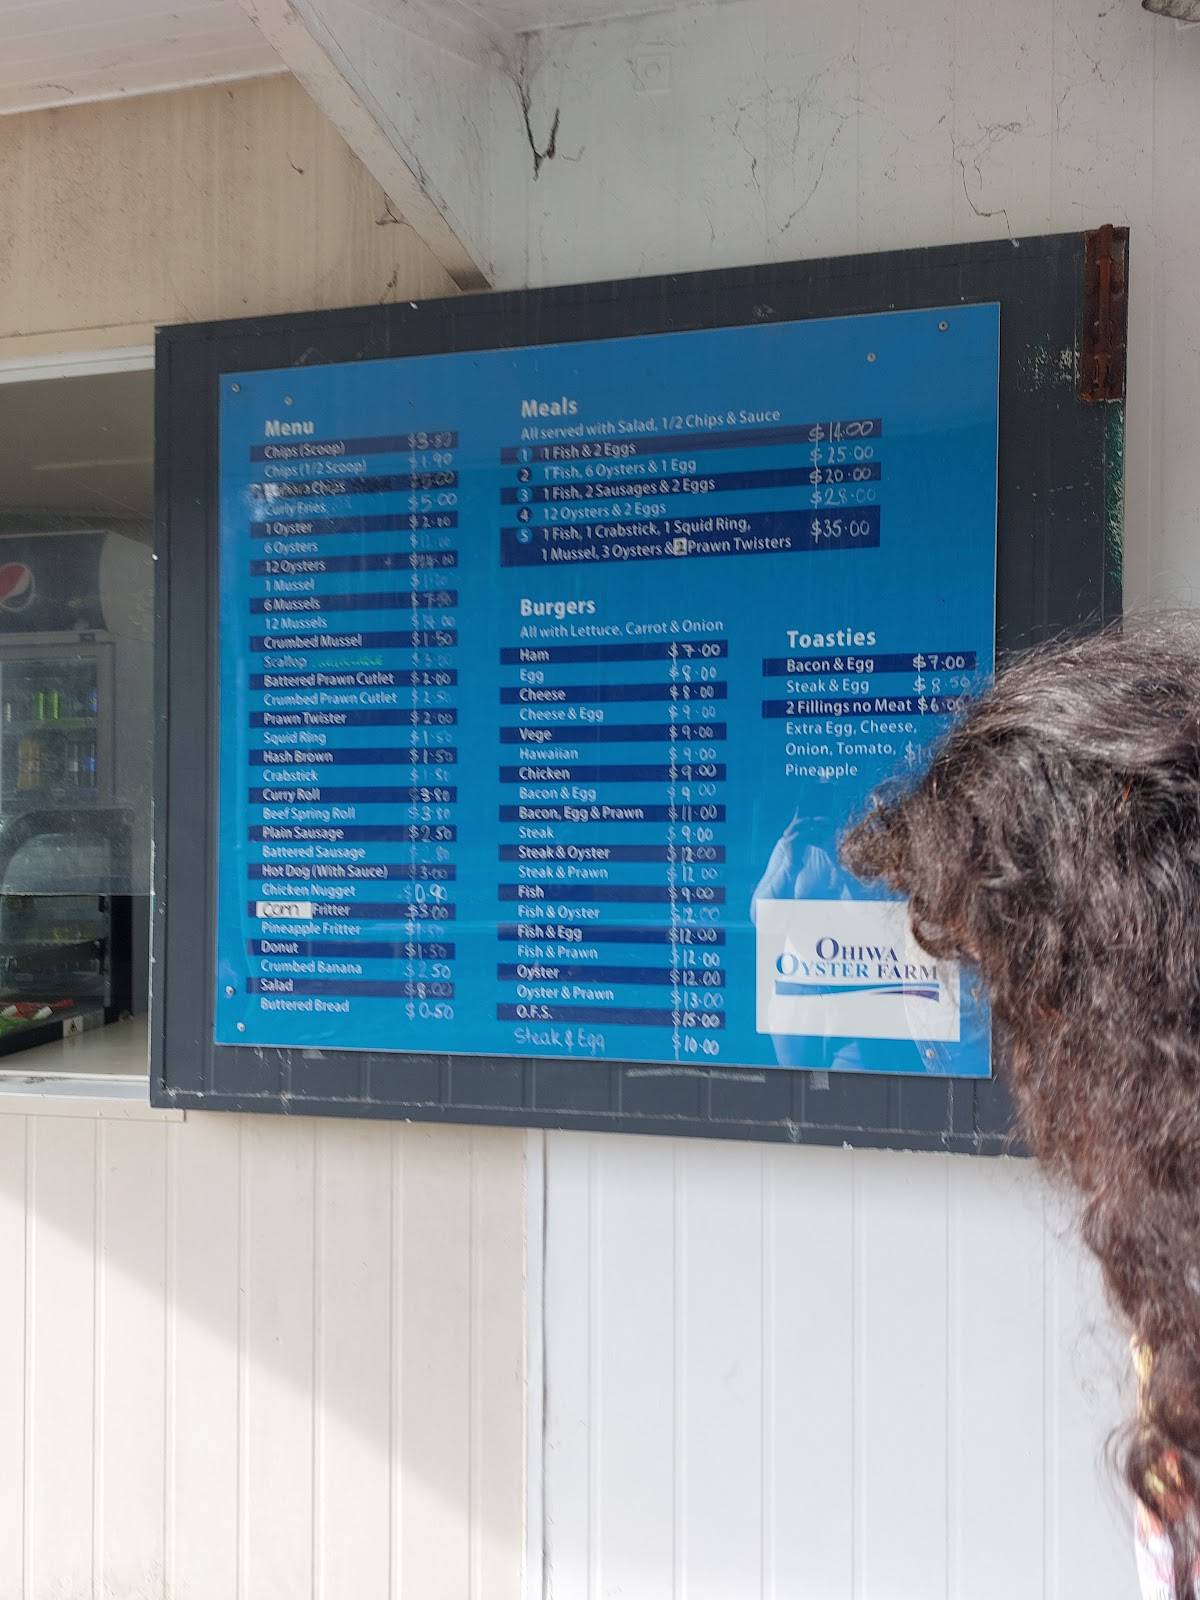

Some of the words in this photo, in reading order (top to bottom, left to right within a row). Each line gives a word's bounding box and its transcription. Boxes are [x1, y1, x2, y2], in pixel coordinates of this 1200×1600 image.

[522, 397, 577, 417] Meals
[265, 421, 314, 436] Menu
[521, 427, 538, 440] All
[540, 424, 584, 439] served
[586, 421, 615, 435] with
[618, 419, 657, 433] Salad,
[662, 416, 683, 429] 1/2
[686, 415, 723, 428] Chips
[740, 411, 780, 423] Sauce
[299, 443, 345, 457] (Scoop)
[553, 445, 579, 459] Fish
[604, 443, 636, 458] Eggs
[550, 466, 583, 479] Fish,
[596, 464, 645, 478] Oysters
[671, 459, 696, 474] Egg
[553, 486, 583, 500] Fish,
[595, 484, 657, 497] Sausages
[683, 478, 715, 494] Eggs
[544, 508, 558, 520] 12
[560, 507, 609, 520] Oysters
[635, 502, 666, 517] Eggs
[273, 522, 313, 536] Oyster
[553, 527, 583, 540] Fish,
[595, 523, 661, 537] Crabstick,
[674, 519, 713, 538] Squid
[716, 518, 750, 533] Ring,
[273, 541, 318, 555] Oysters
[551, 547, 599, 560] Mussel,
[612, 545, 662, 559] Oysters
[687, 540, 730, 553] Prawn
[733, 537, 791, 550] Twisters
[280, 560, 326, 575] Oysters
[274, 579, 314, 591] Mussel
[273, 598, 320, 610] Mussels
[521, 599, 595, 619] Burgers
[281, 617, 327, 629] Mussels
[520, 625, 537, 639] All
[539, 625, 568, 637] with
[571, 625, 622, 637] Lettuce,
[626, 622, 667, 635] Carrot
[682, 620, 723, 632] Onion
[264, 636, 319, 649] Crumbed
[320, 635, 362, 647] Mussel
[787, 628, 876, 648] Toasties
[264, 656, 307, 669] Scallop
[520, 649, 549, 661] Ham
[787, 659, 830, 672] Bacon
[847, 657, 873, 673] Egg
[264, 675, 315, 687] Battered
[317, 673, 355, 685] Prawn
[356, 672, 394, 685] Cutlet
[520, 669, 544, 684] Egg
[787, 680, 825, 693] Steak
[843, 678, 869, 694] Egg
[264, 693, 318, 705] Crumbed
[320, 692, 358, 704] Prawn
[359, 692, 397, 704] Cutlet
[520, 688, 566, 701] Cheese
[520, 708, 568, 720] Cheese
[580, 707, 603, 722] Egg
[798, 700, 849, 716] Fillings
[853, 702, 871, 712] no
[875, 699, 911, 712] Meat
[264, 713, 301, 725] Prawn
[302, 712, 347, 724] Twister
[519, 728, 552, 743] Vege
[786, 722, 822, 735] Extra
[826, 721, 856, 737] Egg,
[861, 720, 916, 733] Cheese,
[264, 732, 298, 745] Squid
[299, 731, 326, 745] Ring
[520, 748, 578, 760] Hawaiian
[786, 743, 832, 755] Onion,
[837, 742, 896, 755] Tomato,
[263, 751, 293, 763] Hash
[294, 750, 333, 762] Brown
[263, 770, 318, 781] Crabstick
[519, 767, 570, 780] Chicken
[786, 764, 857, 779] Pineapple
[263, 789, 296, 802] Curry
[297, 788, 320, 801] Roll
[519, 787, 558, 799] Bacon
[572, 786, 596, 802] Egg
[263, 807, 289, 819] Beef
[291, 808, 330, 822] Spring
[332, 807, 355, 819] Roll
[519, 806, 561, 819] Bacon,
[564, 806, 588, 822] Egg
[602, 806, 643, 819] Prawn
[263, 826, 294, 839] Plain
[293, 827, 344, 841] Sausage
[519, 826, 554, 838] Steak
[262, 845, 314, 857] Battered
[315, 846, 366, 860] Sausage
[519, 845, 554, 859] Steak
[567, 846, 610, 861] Oyster
[262, 864, 286, 877] Hot
[285, 864, 310, 880] Dog
[312, 865, 345, 877] (With
[347, 865, 388, 878] Sauce)
[519, 865, 553, 878] Steak
[568, 866, 608, 878] Prawn
[262, 883, 310, 896] Chicken
[310, 884, 356, 899] Nugget
[518, 885, 544, 898] Fish
[263, 903, 300, 916] Corn
[312, 903, 350, 916] Fritter
[518, 905, 544, 918] Fish
[557, 906, 600, 920] Oyster
[262, 922, 321, 936] Pineapple
[323, 922, 361, 935] Fritter
[518, 924, 544, 938] Fish
[557, 925, 582, 942] Egg
[261, 940, 298, 953] Donut
[518, 945, 543, 958] Fish
[557, 946, 598, 959] Prawn
[816, 937, 898, 961] OHIWA
[261, 960, 315, 972] Crumbed
[317, 961, 362, 974] Banana
[517, 963, 559, 980] Oyster
[776, 954, 869, 977] OYSTER
[878, 965, 937, 980] FARM
[260, 978, 293, 991] Salad
[517, 985, 559, 1000] Oyster
[573, 986, 614, 1000] Prawn
[261, 998, 313, 1011] Buttered
[314, 999, 349, 1012] Bread
[517, 1005, 553, 1019] O.F.S.
